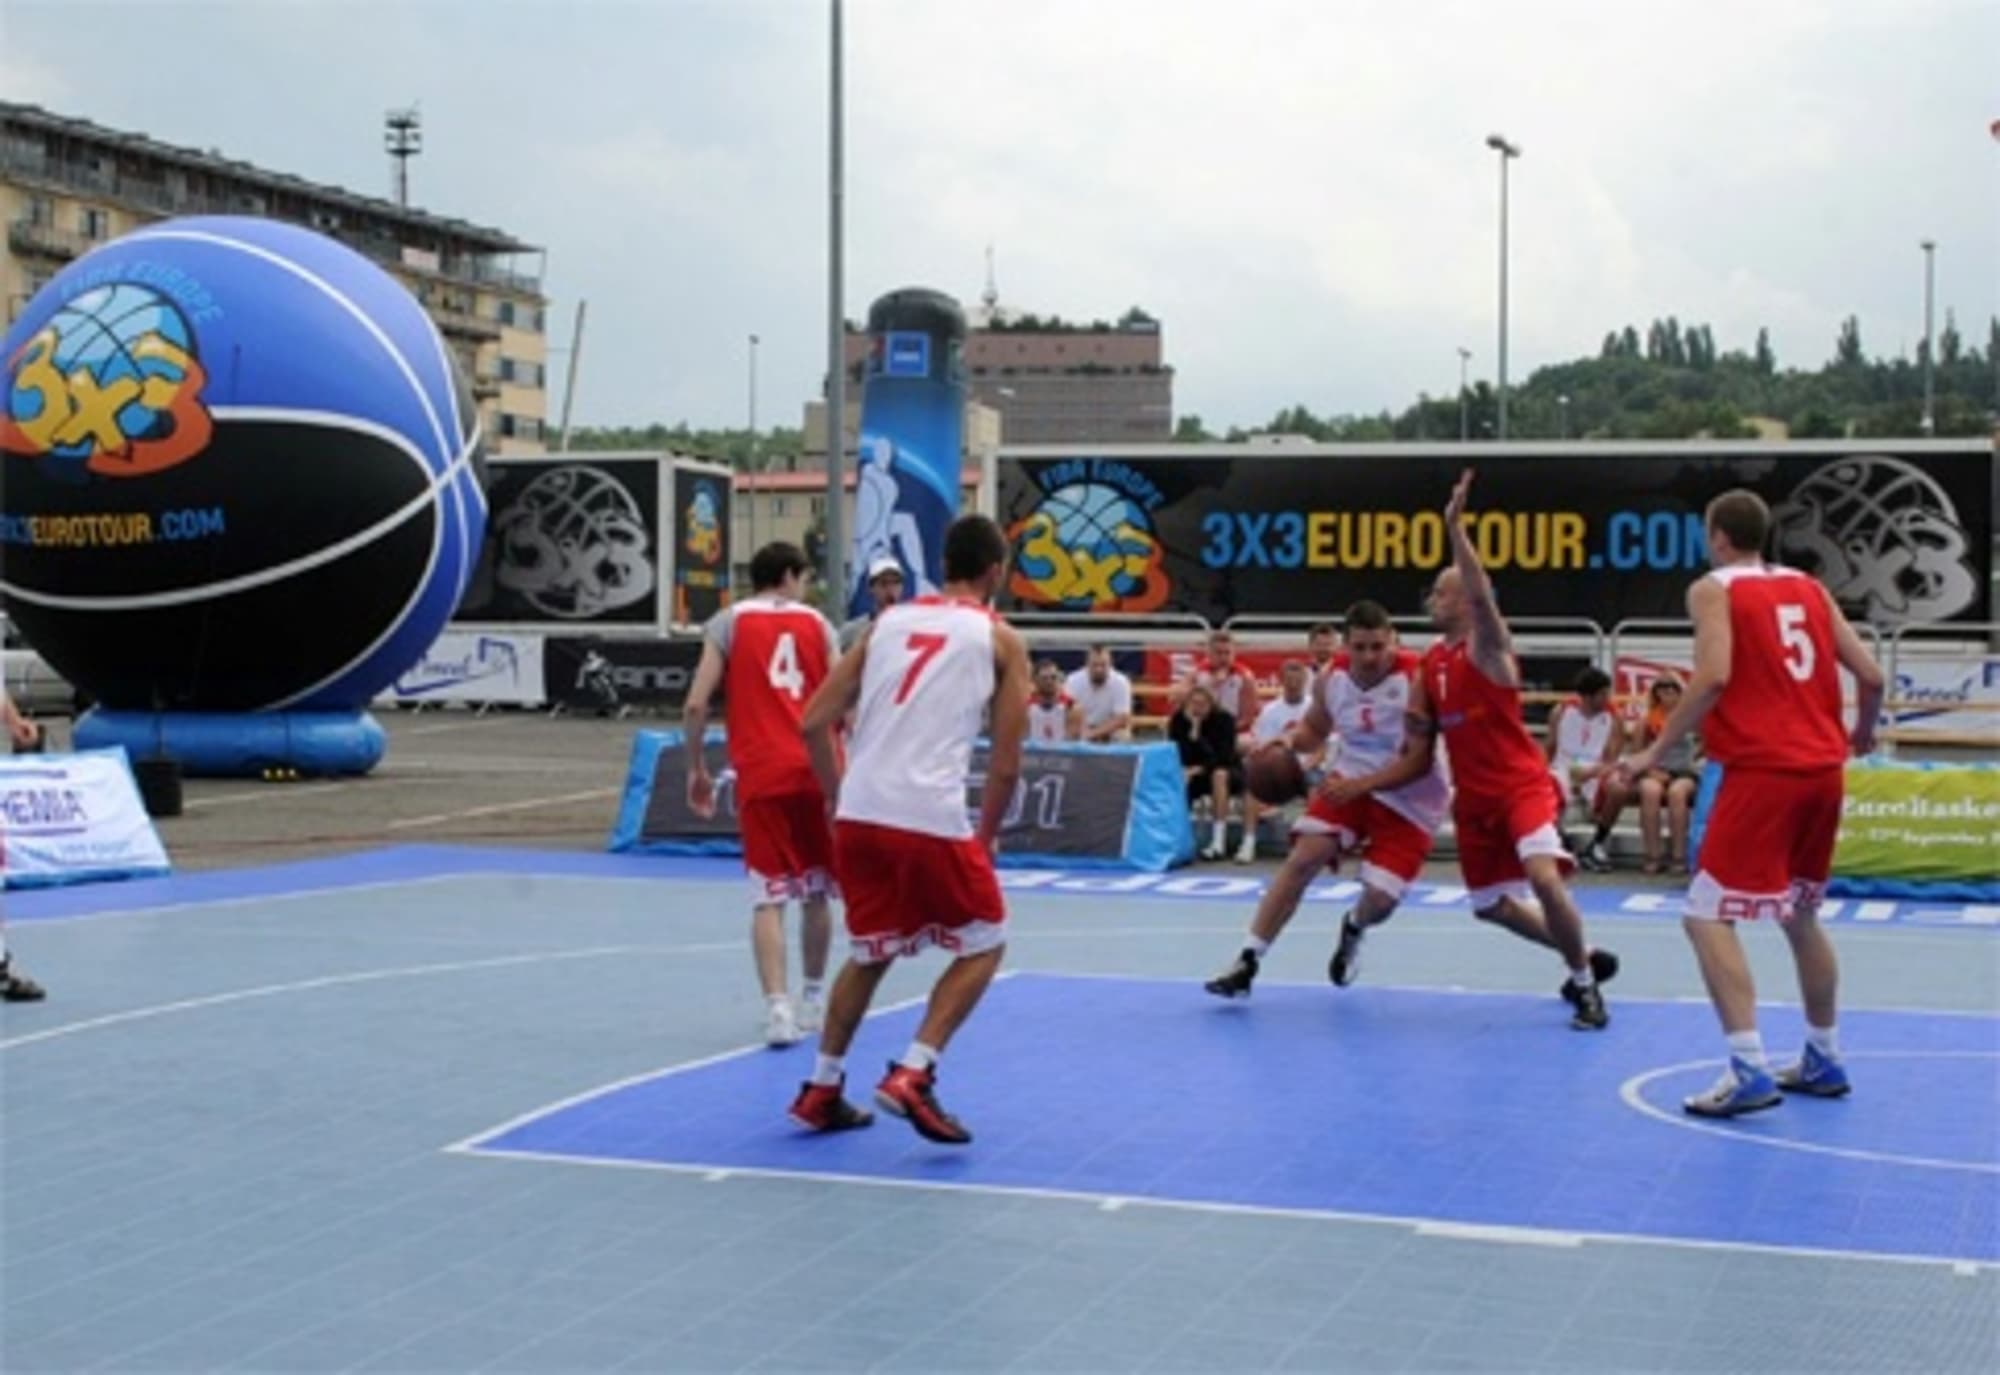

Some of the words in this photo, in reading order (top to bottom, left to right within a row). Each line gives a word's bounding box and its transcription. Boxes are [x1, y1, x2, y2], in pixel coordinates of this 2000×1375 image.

[1202, 512, 1711, 569] 3X3EUROOUR.CO
[768, 632, 804, 698] 4
[893, 633, 947, 704] 7
[1776, 603, 1816, 682] 5
